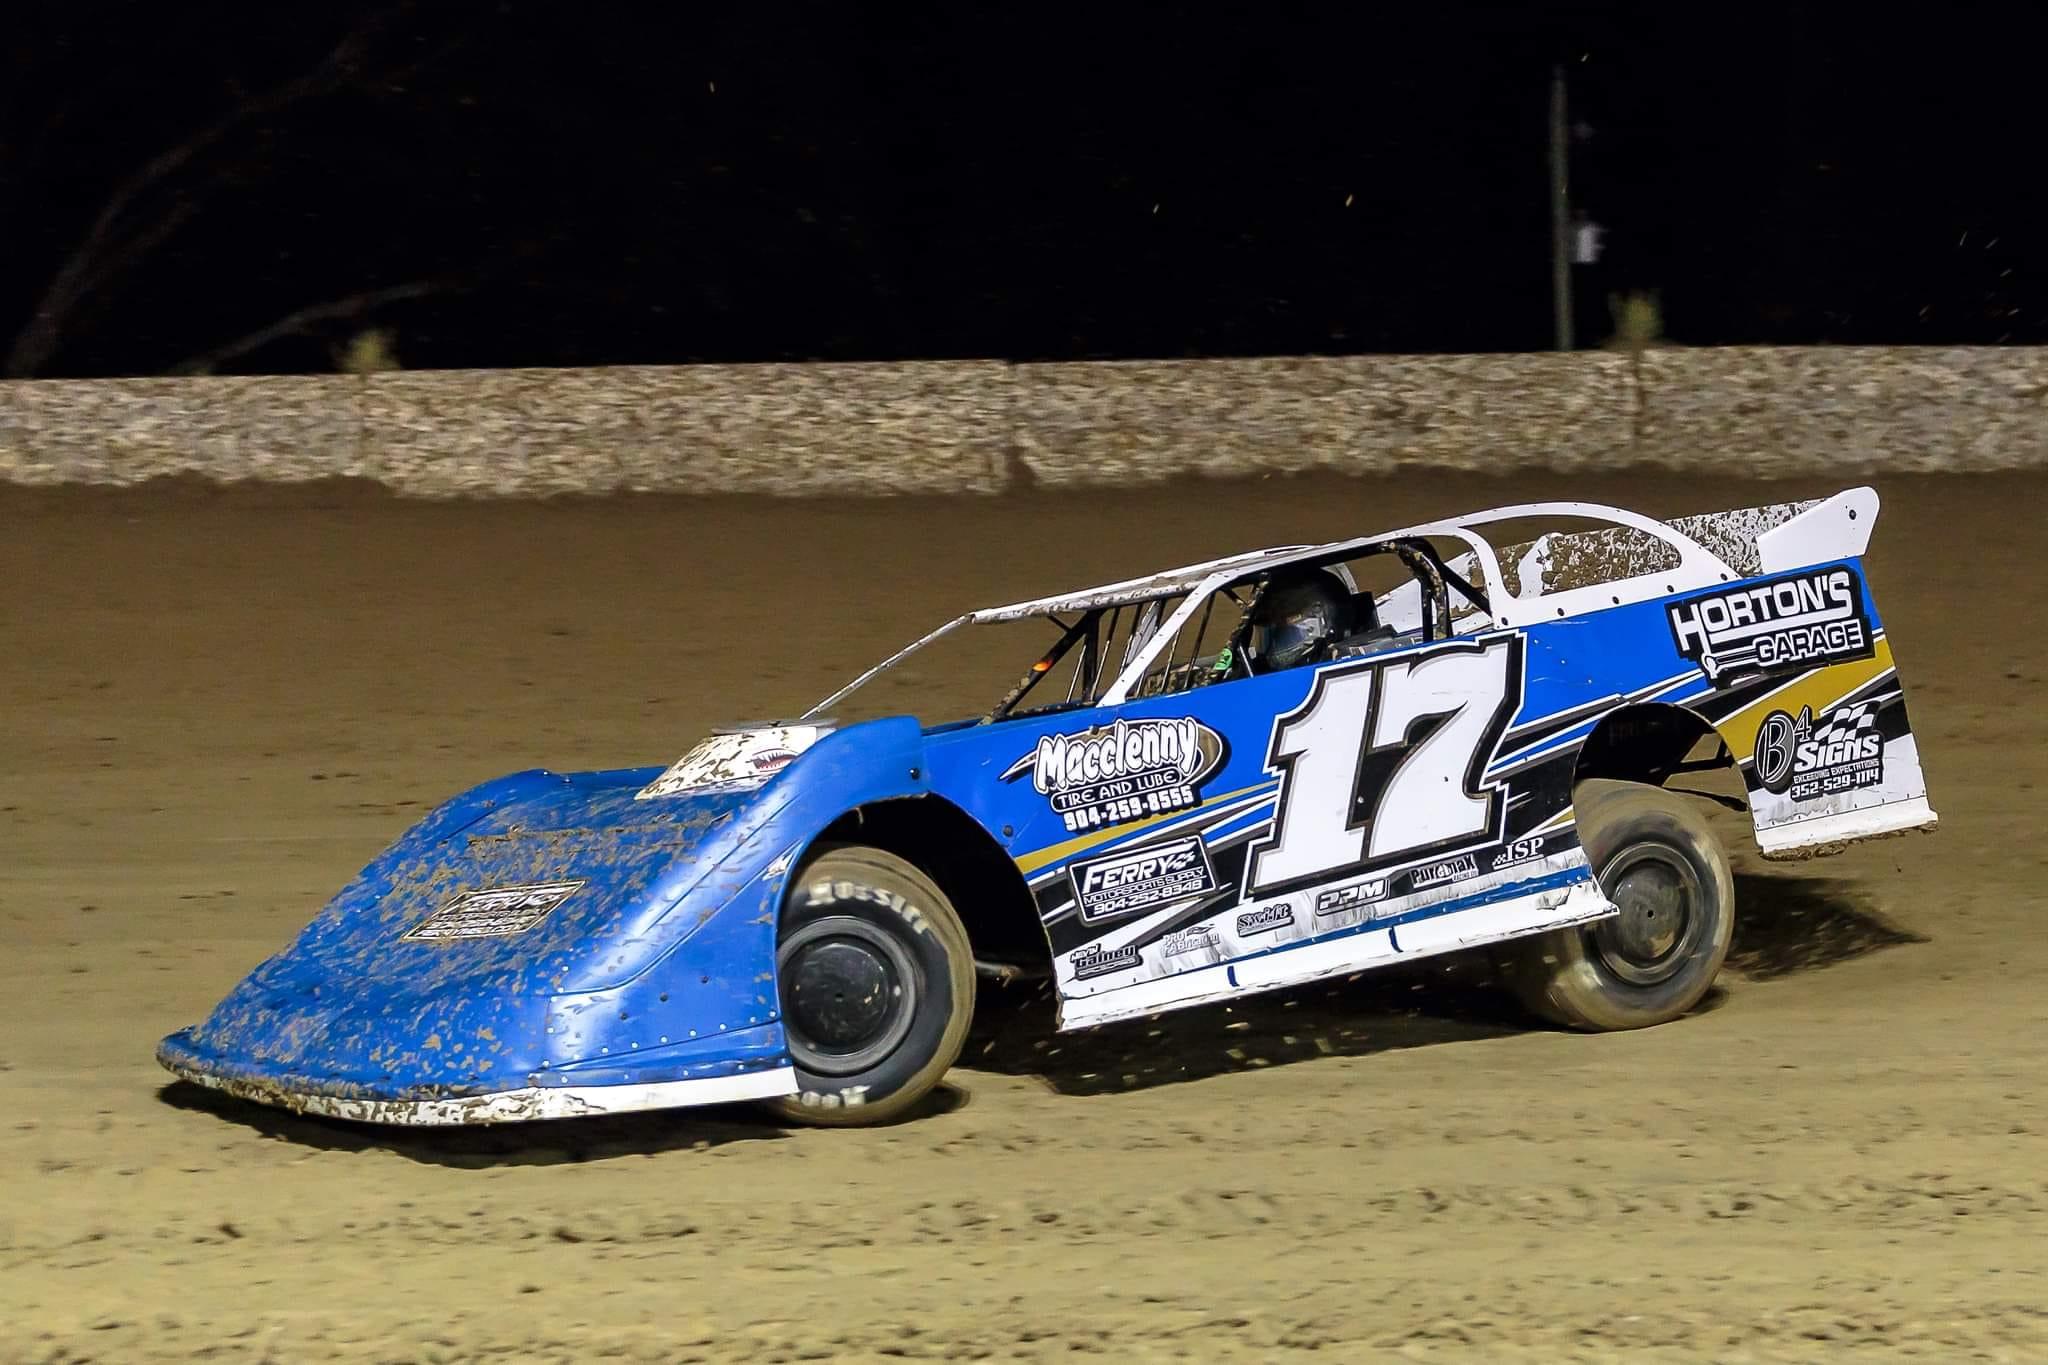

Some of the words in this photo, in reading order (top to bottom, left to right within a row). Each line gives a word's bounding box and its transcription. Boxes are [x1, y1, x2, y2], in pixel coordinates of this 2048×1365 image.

[1672, 571, 1853, 652] HORTON'S
[1754, 619, 1864, 667] GARAGE
[1035, 717, 1199, 791] Macclenny
[1252, 642, 1509, 890] 17
[1058, 791, 1097, 809] TIRE
[1100, 781, 1132, 800] AND
[1137, 772, 1179, 791] LUBE
[1791, 768, 1879, 798] 352-529-1114
[1505, 837, 1545, 862] ISP
[1083, 878, 1166, 905] MOTORSPORTS
[1165, 866, 1205, 885] SUPPLY
[1319, 879, 1385, 911] PPM
[1076, 944, 1137, 969] Gainey
